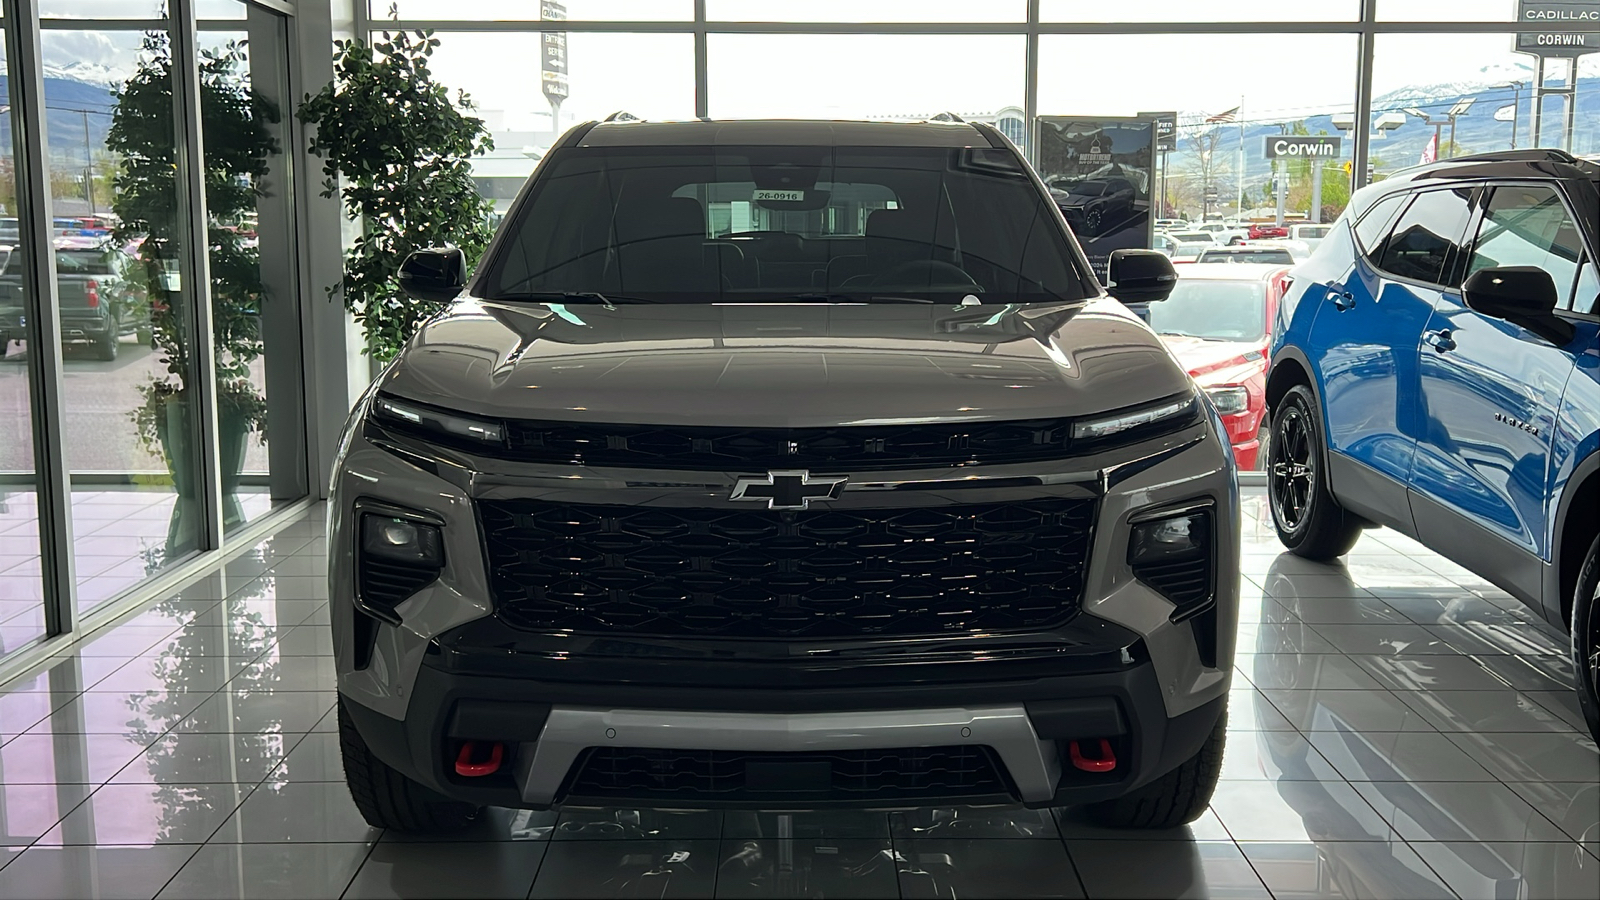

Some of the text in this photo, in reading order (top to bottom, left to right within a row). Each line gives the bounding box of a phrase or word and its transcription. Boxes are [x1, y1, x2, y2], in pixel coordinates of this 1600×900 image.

[1526, 10, 1599, 20] CADILLAC
[1537, 34, 1585, 45] CORWIN
[1274, 139, 1334, 156] Corwin
[758, 192, 798, 200] 26-0916
